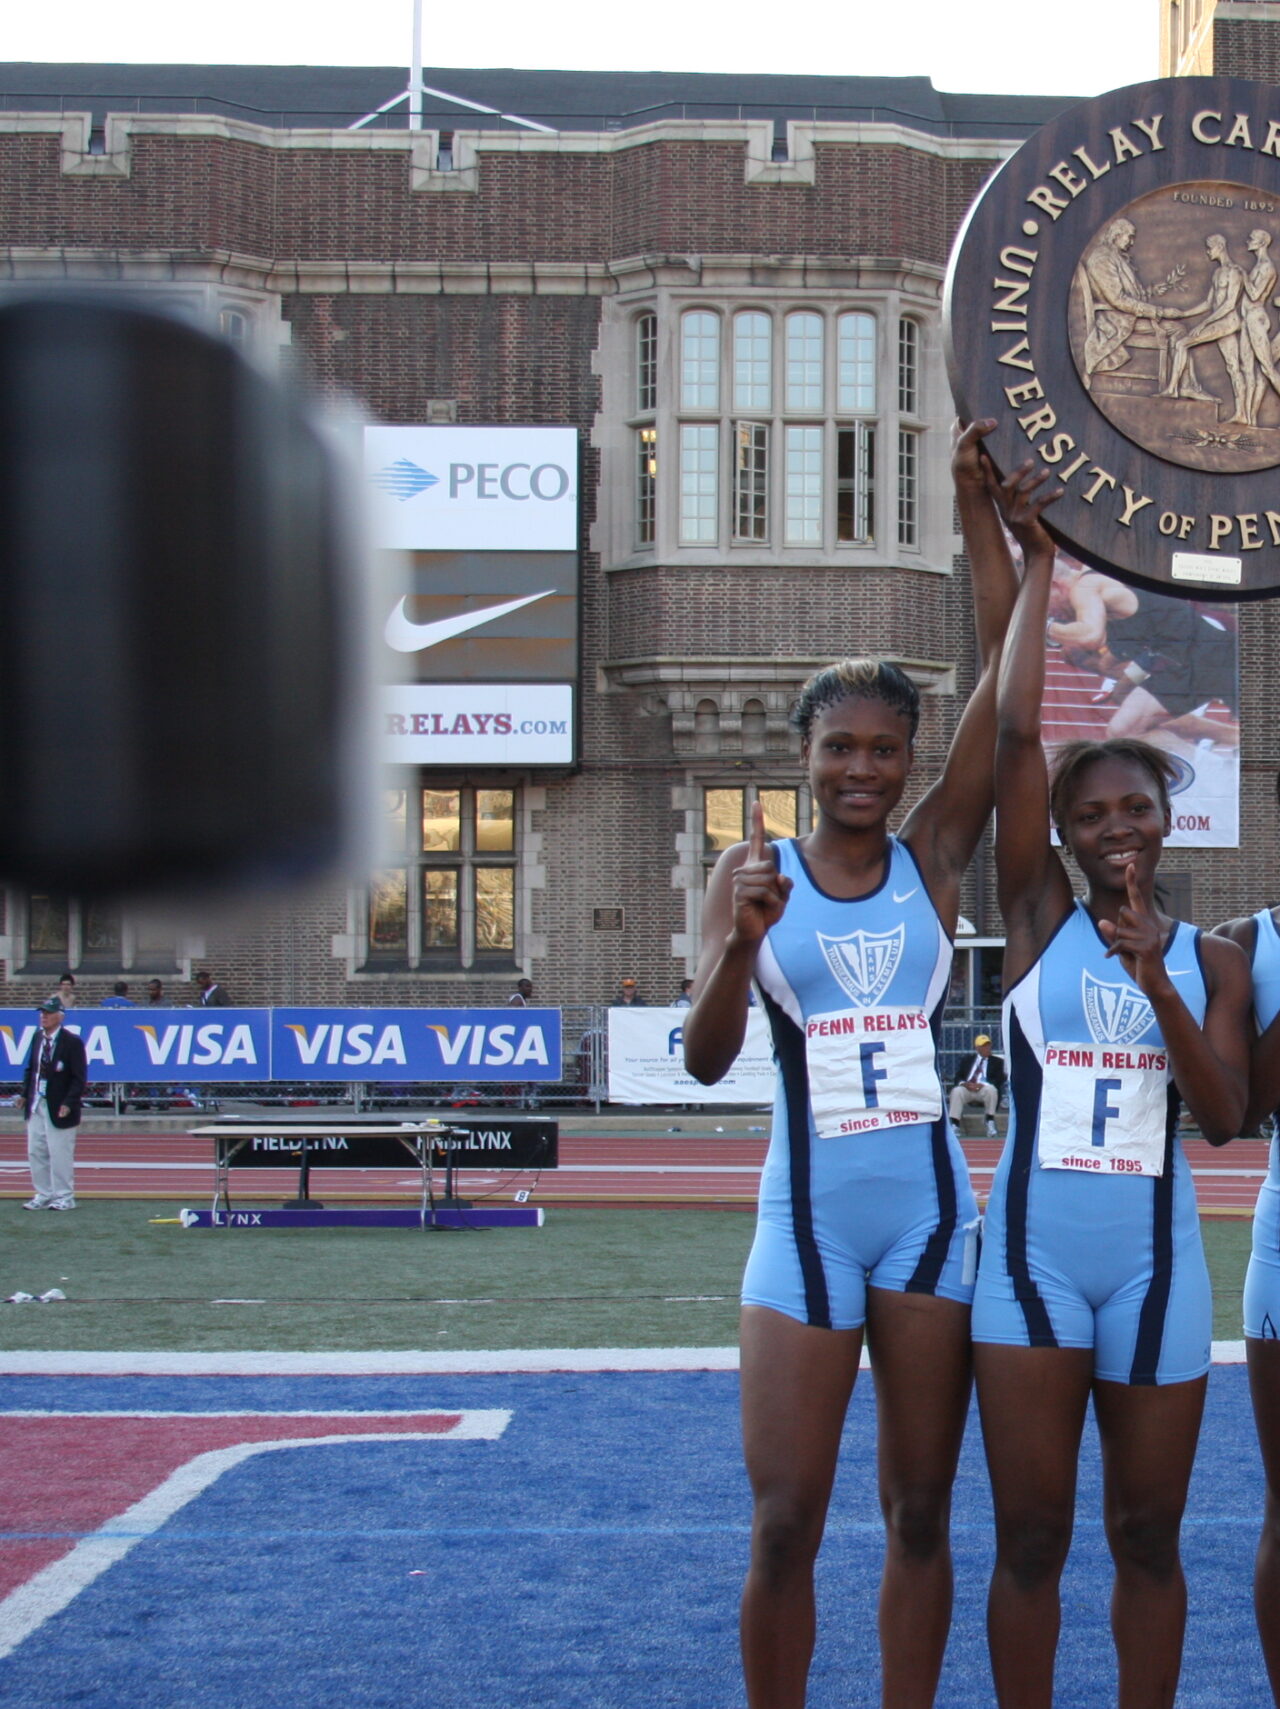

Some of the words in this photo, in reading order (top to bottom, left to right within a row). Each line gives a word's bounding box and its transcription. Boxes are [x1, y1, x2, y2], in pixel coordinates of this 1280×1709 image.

[1027, 115, 1166, 221] RELAY
[1173, 191, 1233, 208] FOUNDED
[1244, 200, 1275, 213] 1895
[992, 245, 1154, 527] UNIVERSITY
[1159, 511, 1196, 540] OF
[449, 463, 570, 501] PECO
[0, 1024, 116, 1065] VA
[133, 1024, 257, 1065] VISA
[283, 1024, 407, 1065] VISA
[426, 1024, 550, 1065] VISA
[807, 1017, 855, 1038] PENN
[863, 1013, 928, 1032] RELAYS
[859, 1041, 888, 1109] F
[1045, 1049, 1094, 1067] PENN
[1102, 1052, 1166, 1070] RELAYS
[840, 1117, 879, 1132] since
[885, 1111, 919, 1124] 1895
[1091, 1078, 1121, 1147] F
[1061, 1155, 1101, 1169] since
[1109, 1158, 1143, 1172] 1895
[215, 1213, 262, 1225] LYNX
